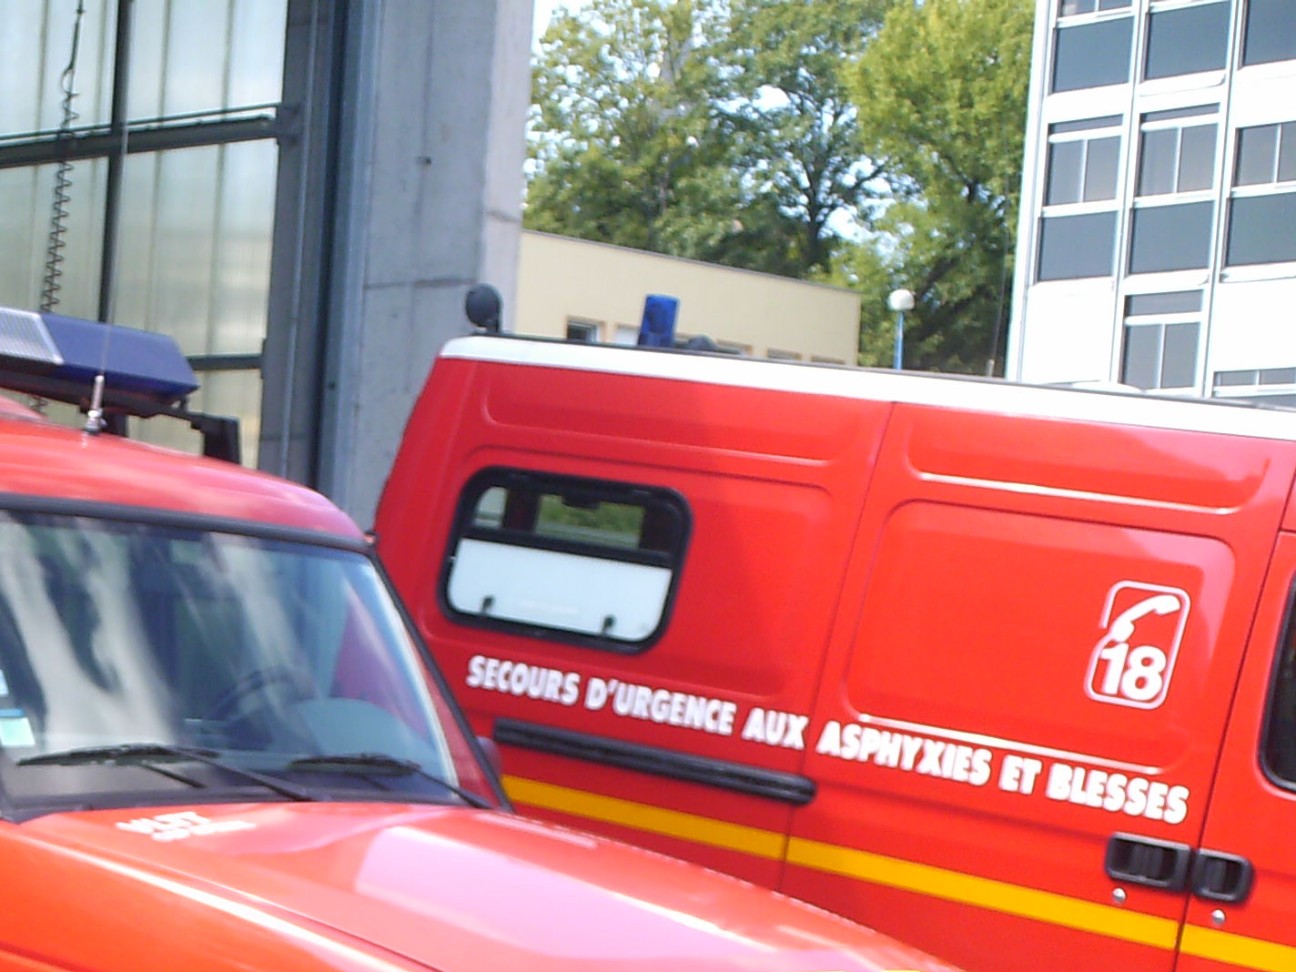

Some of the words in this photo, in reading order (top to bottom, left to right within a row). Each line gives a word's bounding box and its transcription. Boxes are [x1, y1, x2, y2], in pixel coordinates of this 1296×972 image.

[1100, 642, 1167, 701] 18
[465, 655, 580, 705] SECOURS
[584, 677, 737, 736] D'URGENCE
[741, 707, 809, 750] AUX
[816, 720, 992, 786] ASPHYXIES
[998, 754, 1042, 795] ET
[1045, 762, 1190, 825] BLESSES
